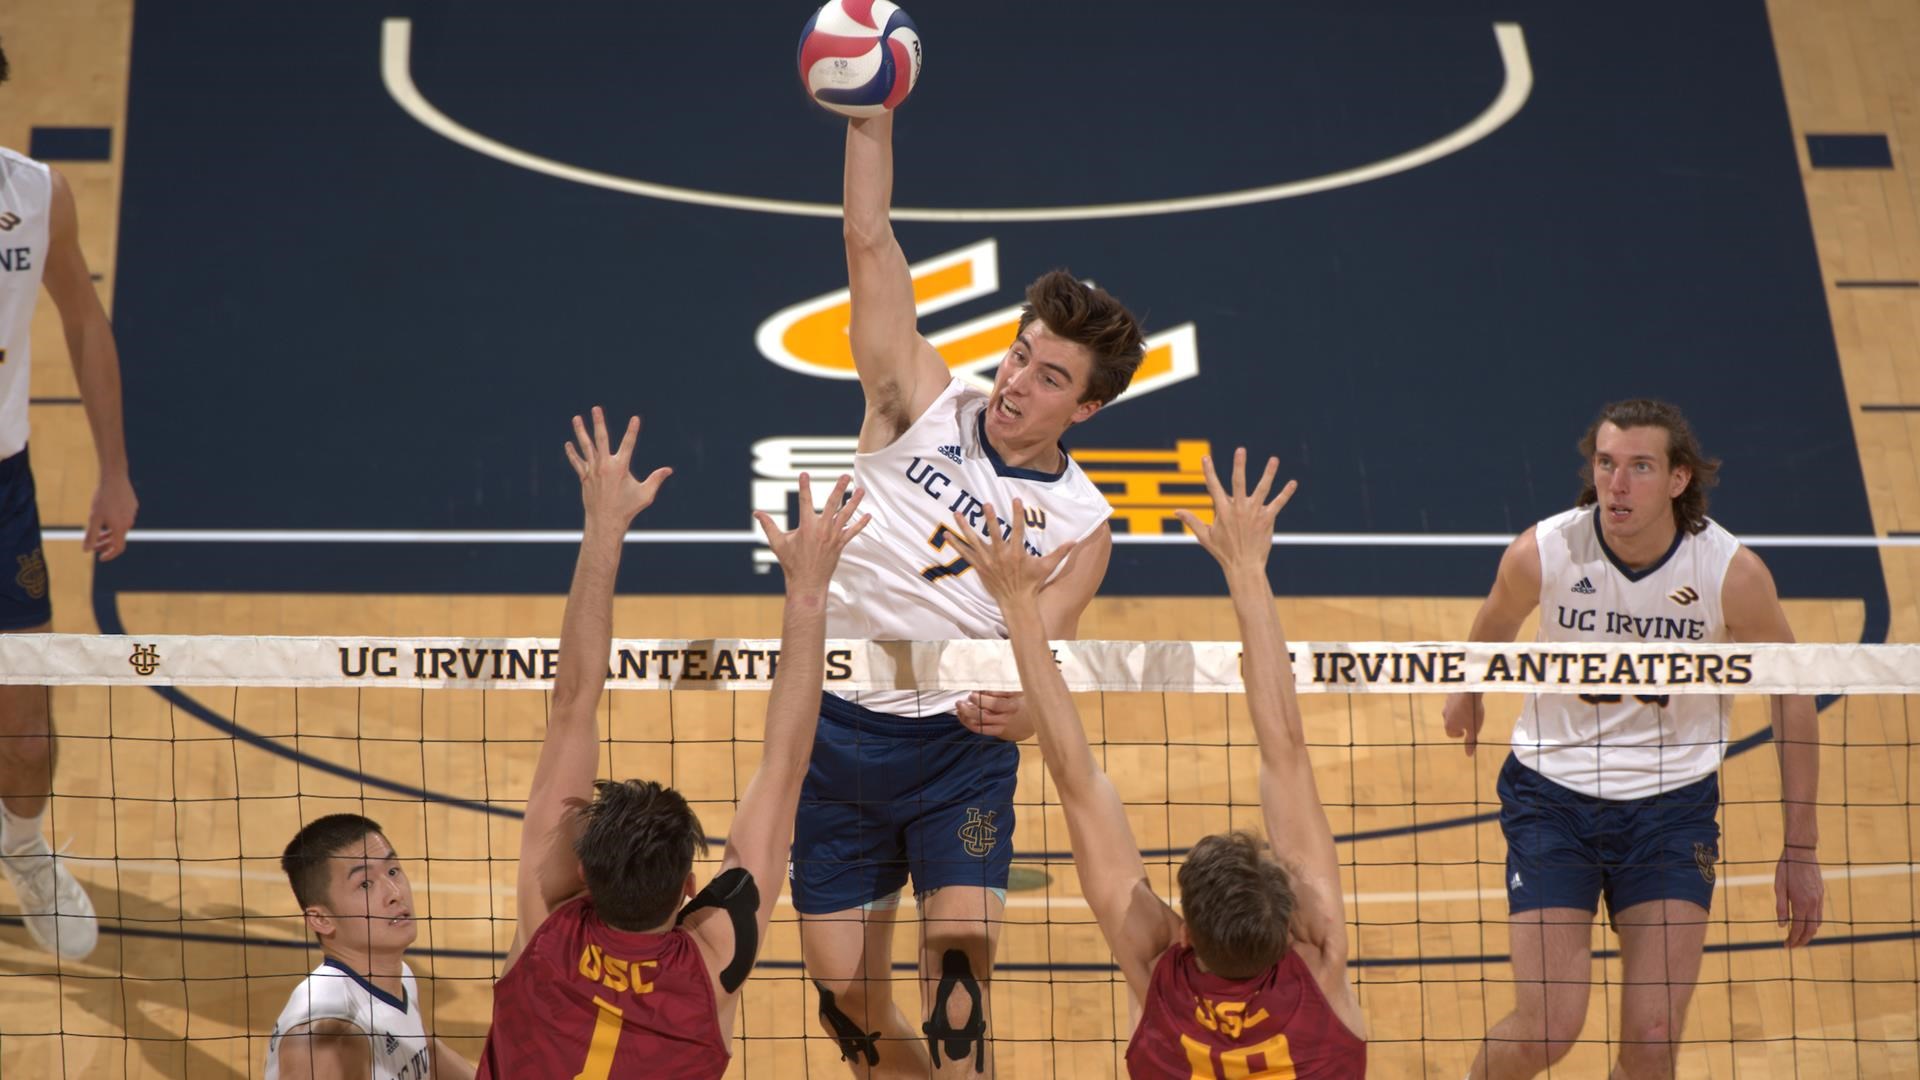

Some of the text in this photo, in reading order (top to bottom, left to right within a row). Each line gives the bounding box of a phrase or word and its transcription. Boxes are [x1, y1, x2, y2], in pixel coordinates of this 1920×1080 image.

[905, 456, 952, 500] UC
[1557, 606, 1705, 640] UC IRVINE
[338, 646, 398, 678] UC
[1312, 652, 1466, 683] IRVINE
[1482, 652, 1753, 684] ANTEATERS
